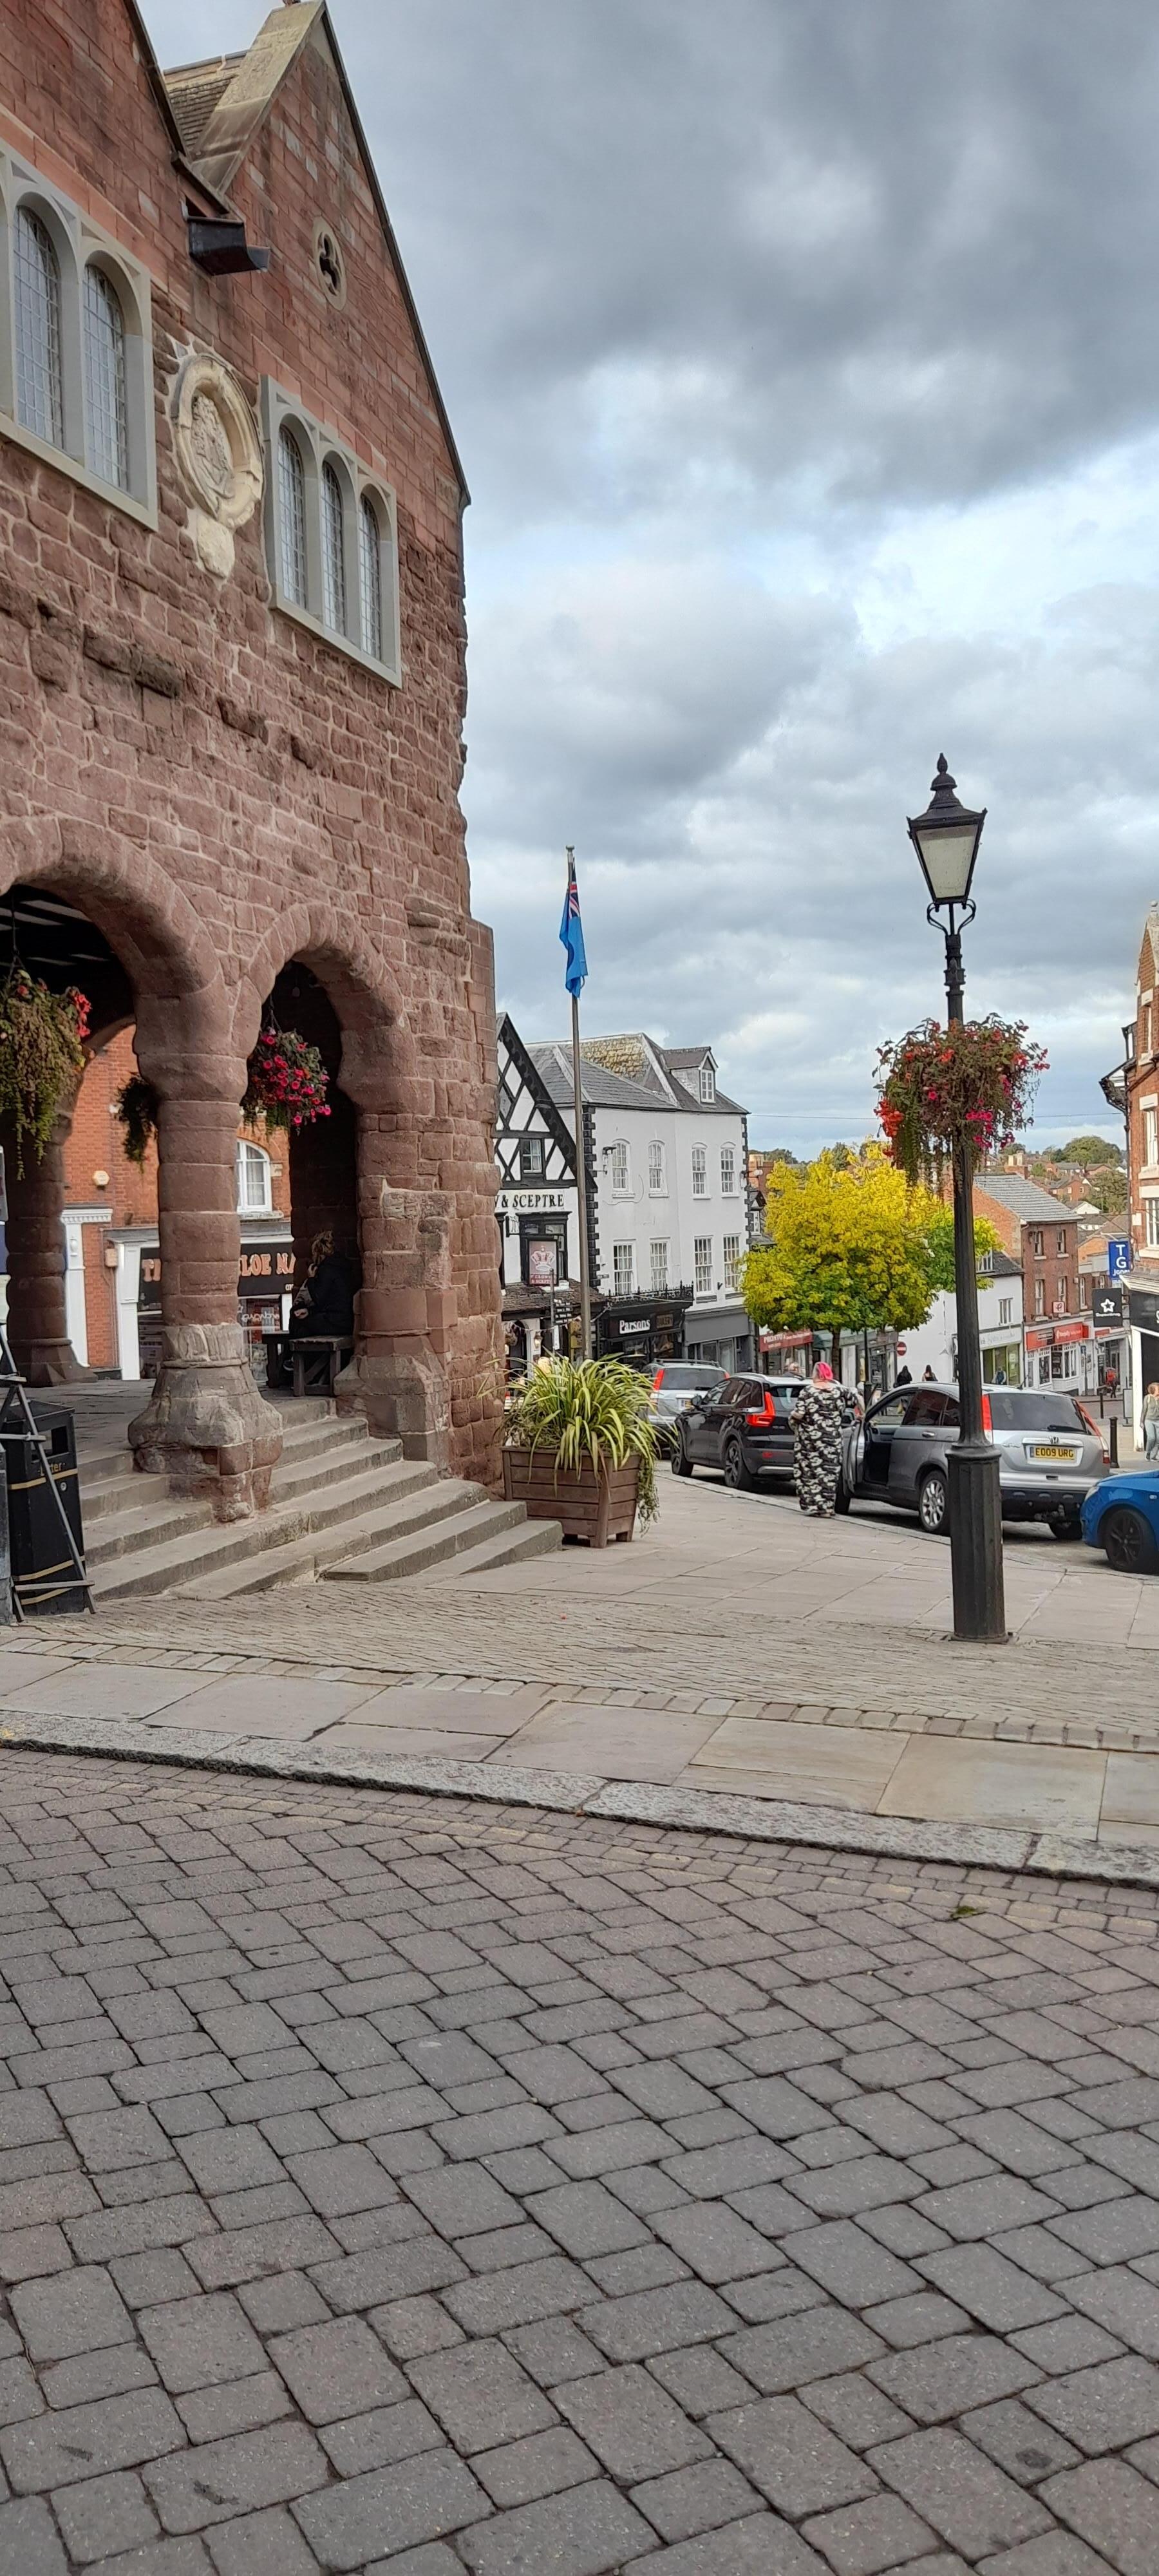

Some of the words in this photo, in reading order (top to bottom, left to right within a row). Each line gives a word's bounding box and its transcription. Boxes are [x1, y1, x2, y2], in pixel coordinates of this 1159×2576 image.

[501, 1195, 509, 1208] &
[513, 1194, 564, 1208] SCEPTRE
[1115, 1244, 1126, 1256] T
[239, 1253, 272, 1276] LOE
[1116, 1256, 1127, 1268] G
[619, 1320, 650, 1334] Parsons
[1058, 1448, 1074, 1457] URG
[40, 1463, 62, 1476] Lter
